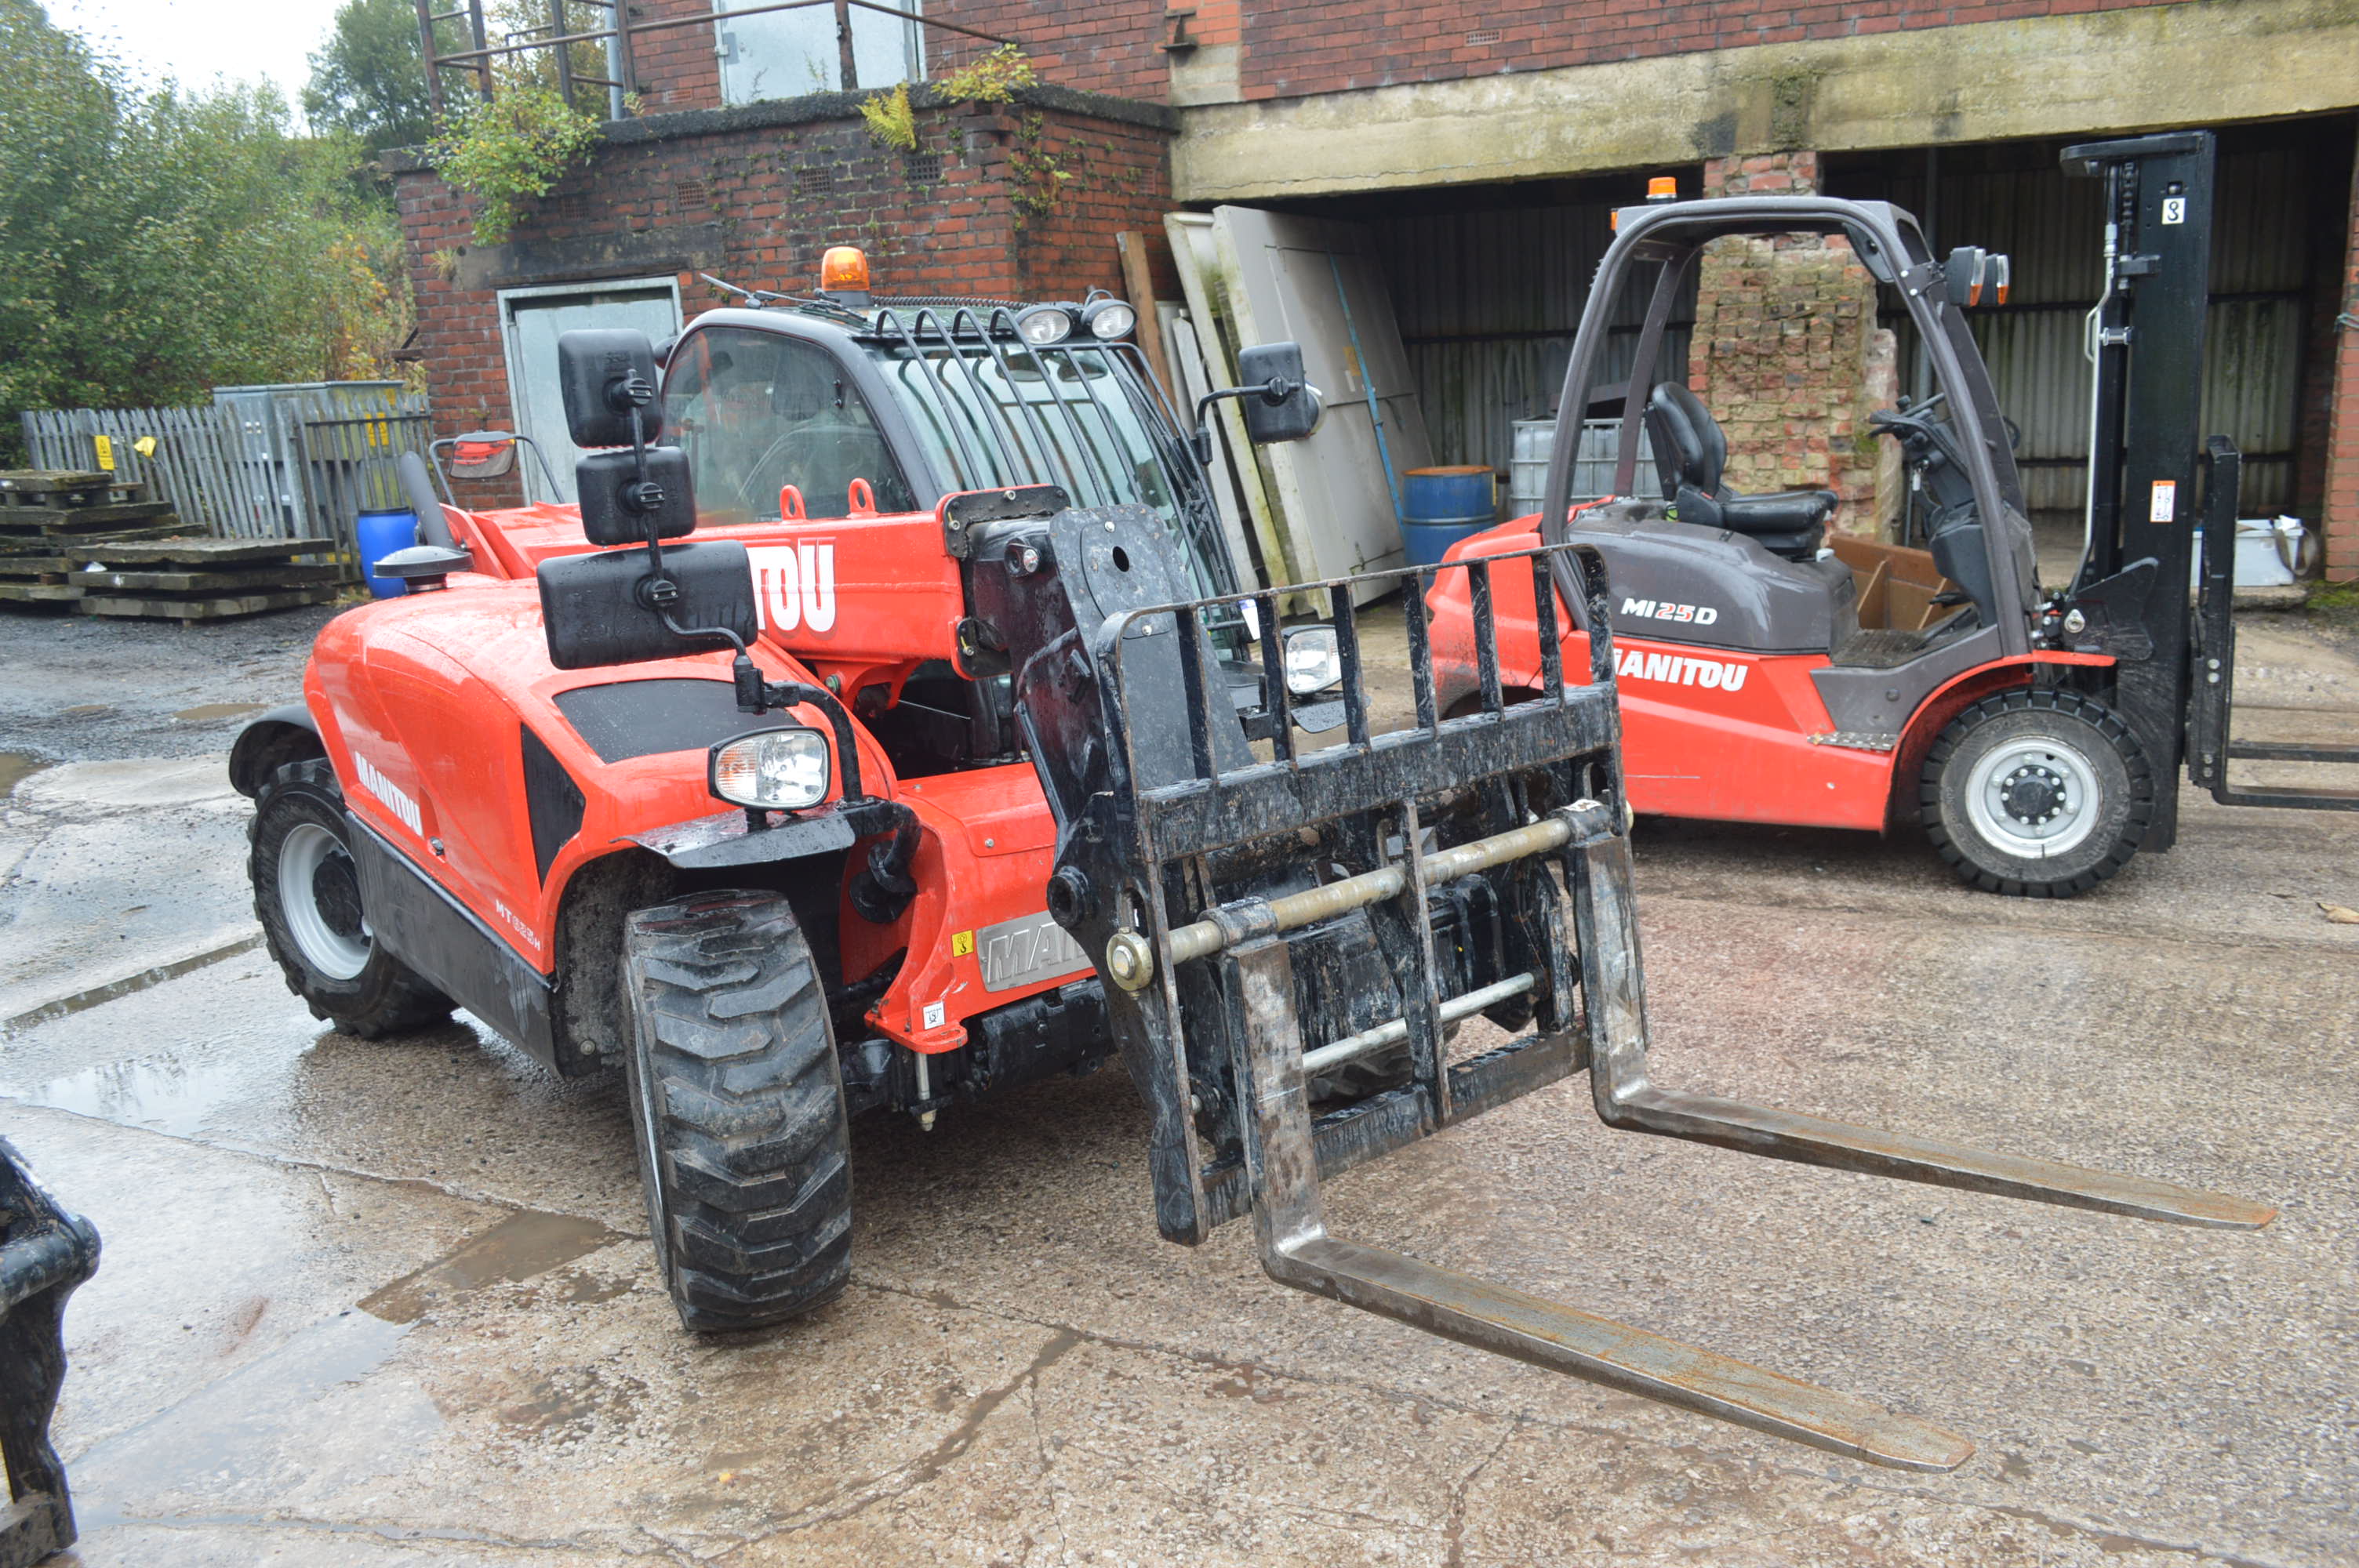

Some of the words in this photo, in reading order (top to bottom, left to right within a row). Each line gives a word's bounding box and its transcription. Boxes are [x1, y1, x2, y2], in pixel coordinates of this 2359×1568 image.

[1621, 598, 1717, 625] MI25D
[1612, 648, 1748, 691] ANITOU
[354, 750, 423, 837] MANITOU
